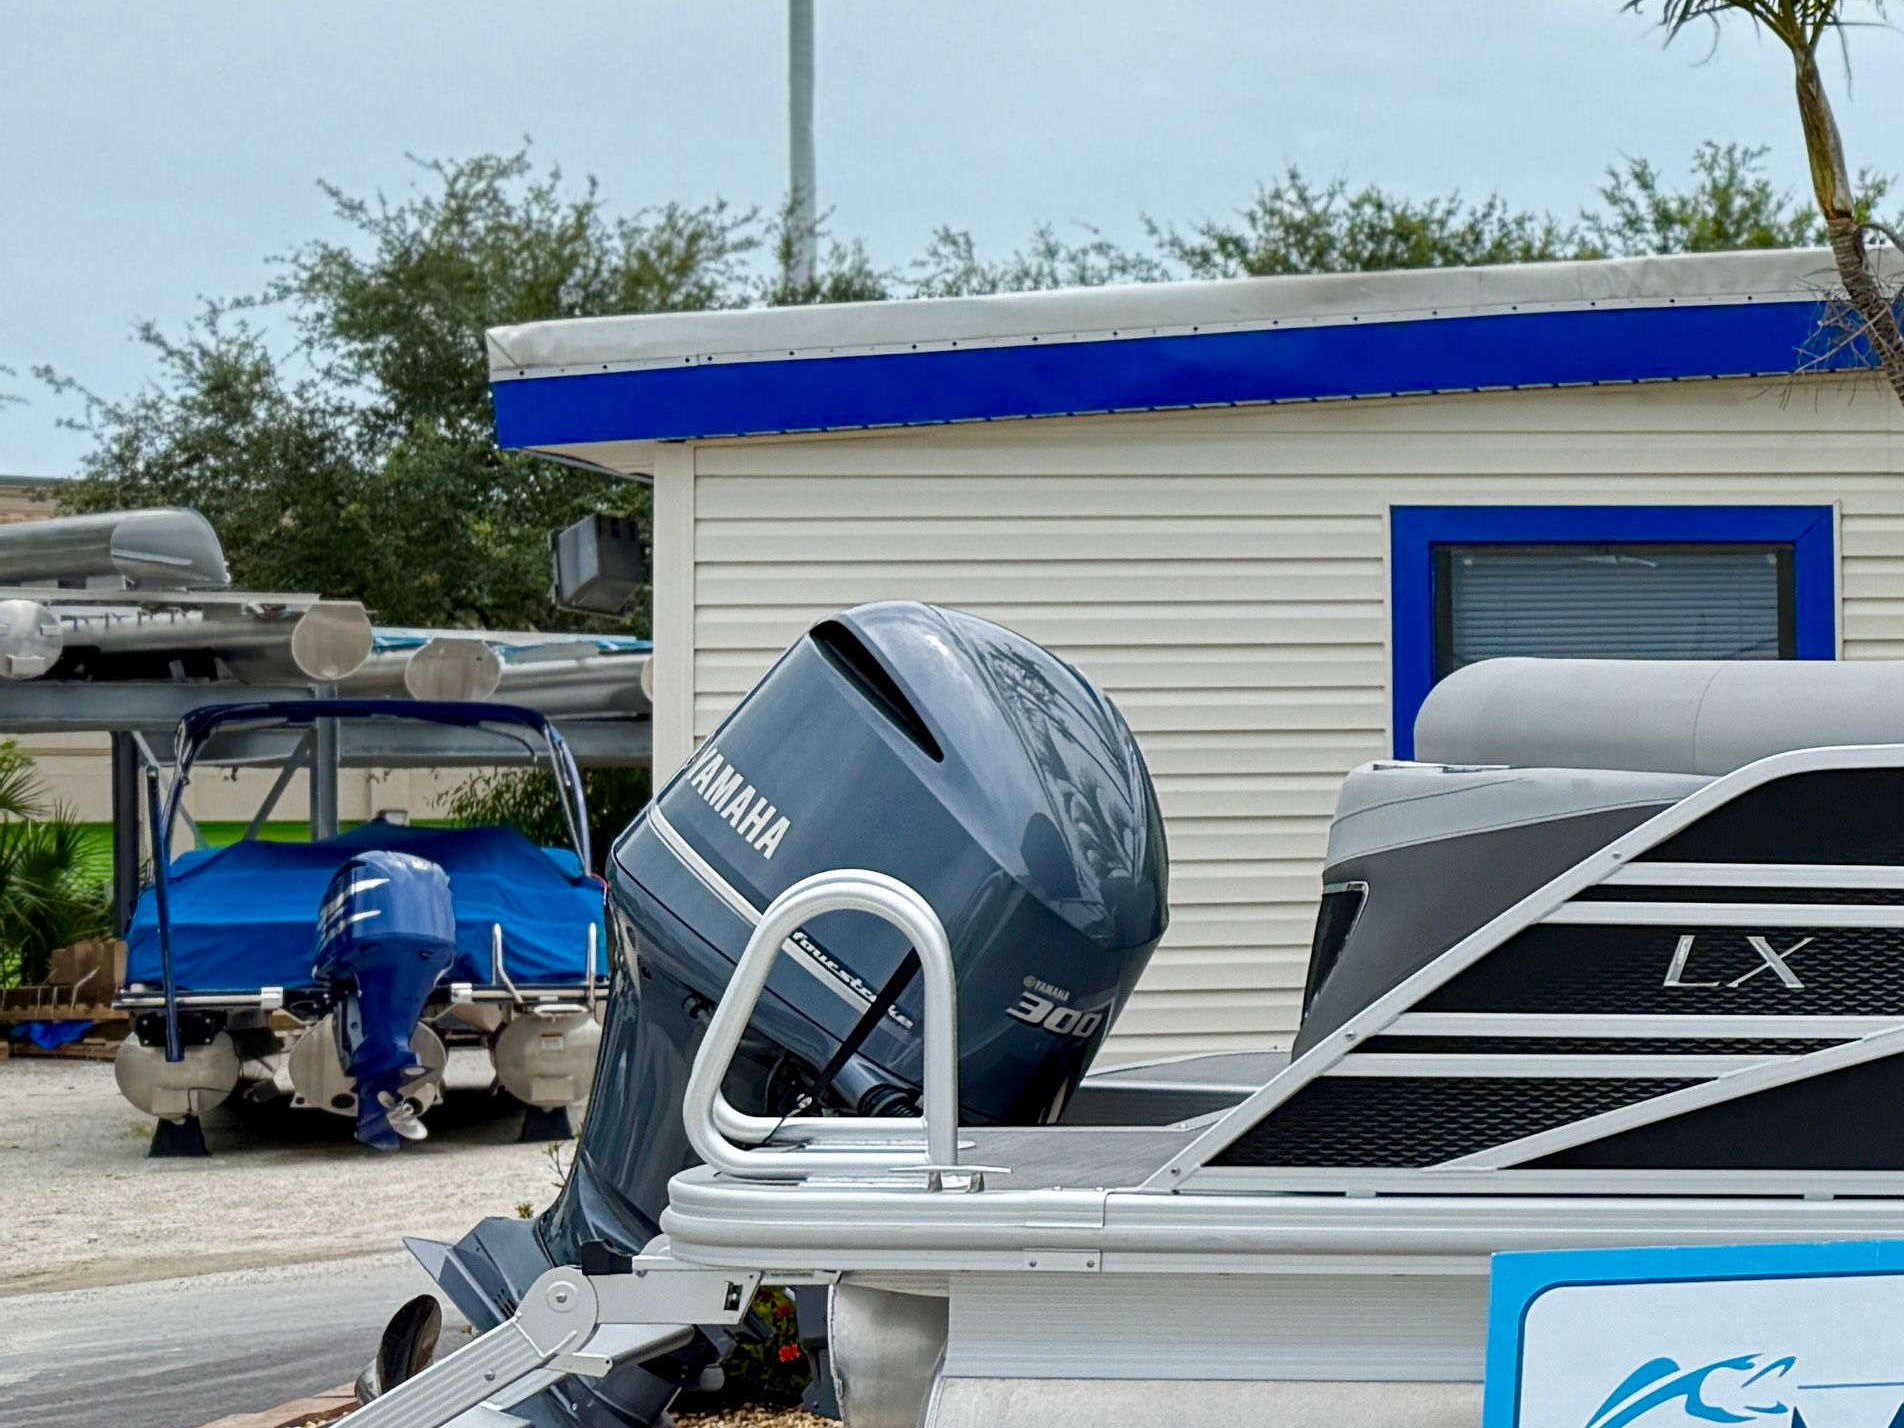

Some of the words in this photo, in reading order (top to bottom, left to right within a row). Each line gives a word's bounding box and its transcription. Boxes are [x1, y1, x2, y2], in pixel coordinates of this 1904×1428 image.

[686, 747, 791, 860] YAMAHA
[792, 931, 914, 1029] fourstrke
[1663, 934, 1815, 988] LX
[1006, 991, 1103, 1039] 300
